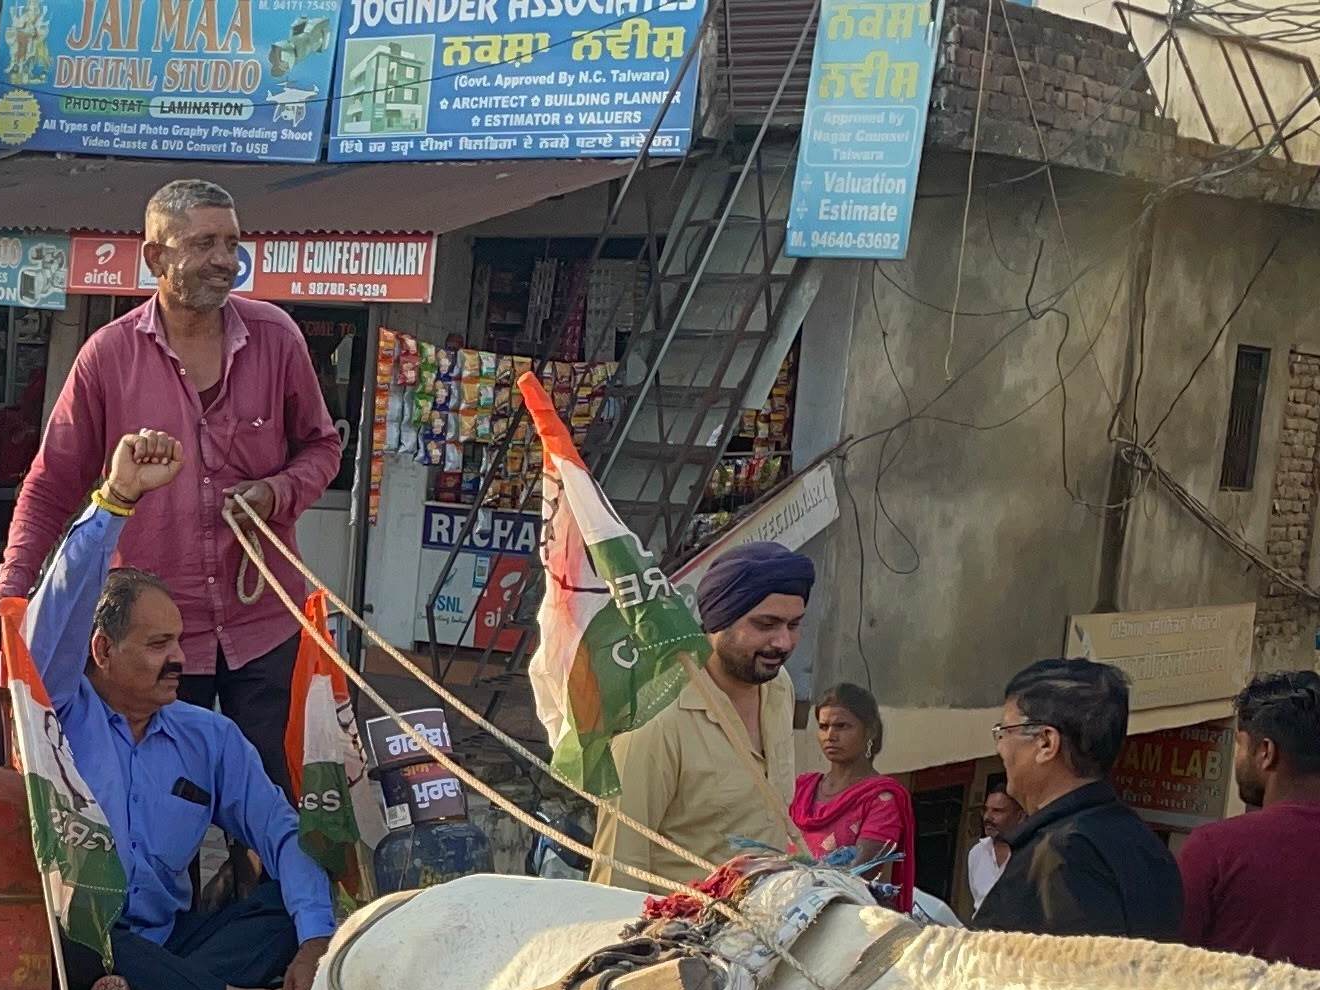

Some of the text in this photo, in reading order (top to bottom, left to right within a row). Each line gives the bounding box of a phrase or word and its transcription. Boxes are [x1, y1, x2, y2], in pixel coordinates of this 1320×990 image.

[66, 0, 254, 53] JAI MAA
[348, 0, 498, 33] JOGINDER
[53, 56, 262, 94] DIGITAL STUDIO
[453, 69, 669, 90] (Govt. Approved By N.C. Talwara)
[64, 97, 144, 114] PHOTO STAT
[159, 100, 243, 116] LAMINATION
[453, 90, 681, 109] ARCHITECT BUILDING PLANNER
[484, 111, 642, 127] ESTIMATOR VALUERS
[43, 119, 313, 142] All Types of Digital Photo Graphy Pre-Wedding Shoot
[82, 136, 110, 148] Video
[150, 139, 159, 150] &
[161, 139, 184, 151] DVD
[186, 141, 227, 153] Convert
[230, 142, 243, 153] To
[245, 143, 269, 155] USB
[824, 171, 906, 194] Valuation
[818, 199, 898, 222] Estimate
[791, 231, 900, 250] M. 94640-63692
[303, 241, 428, 275] CONFECTIONARY
[84, 270, 123, 286] airtel
[291, 282, 304, 295] M.
[437, 595, 463, 613] SNL
[1170, 747, 1222, 780] LAB
